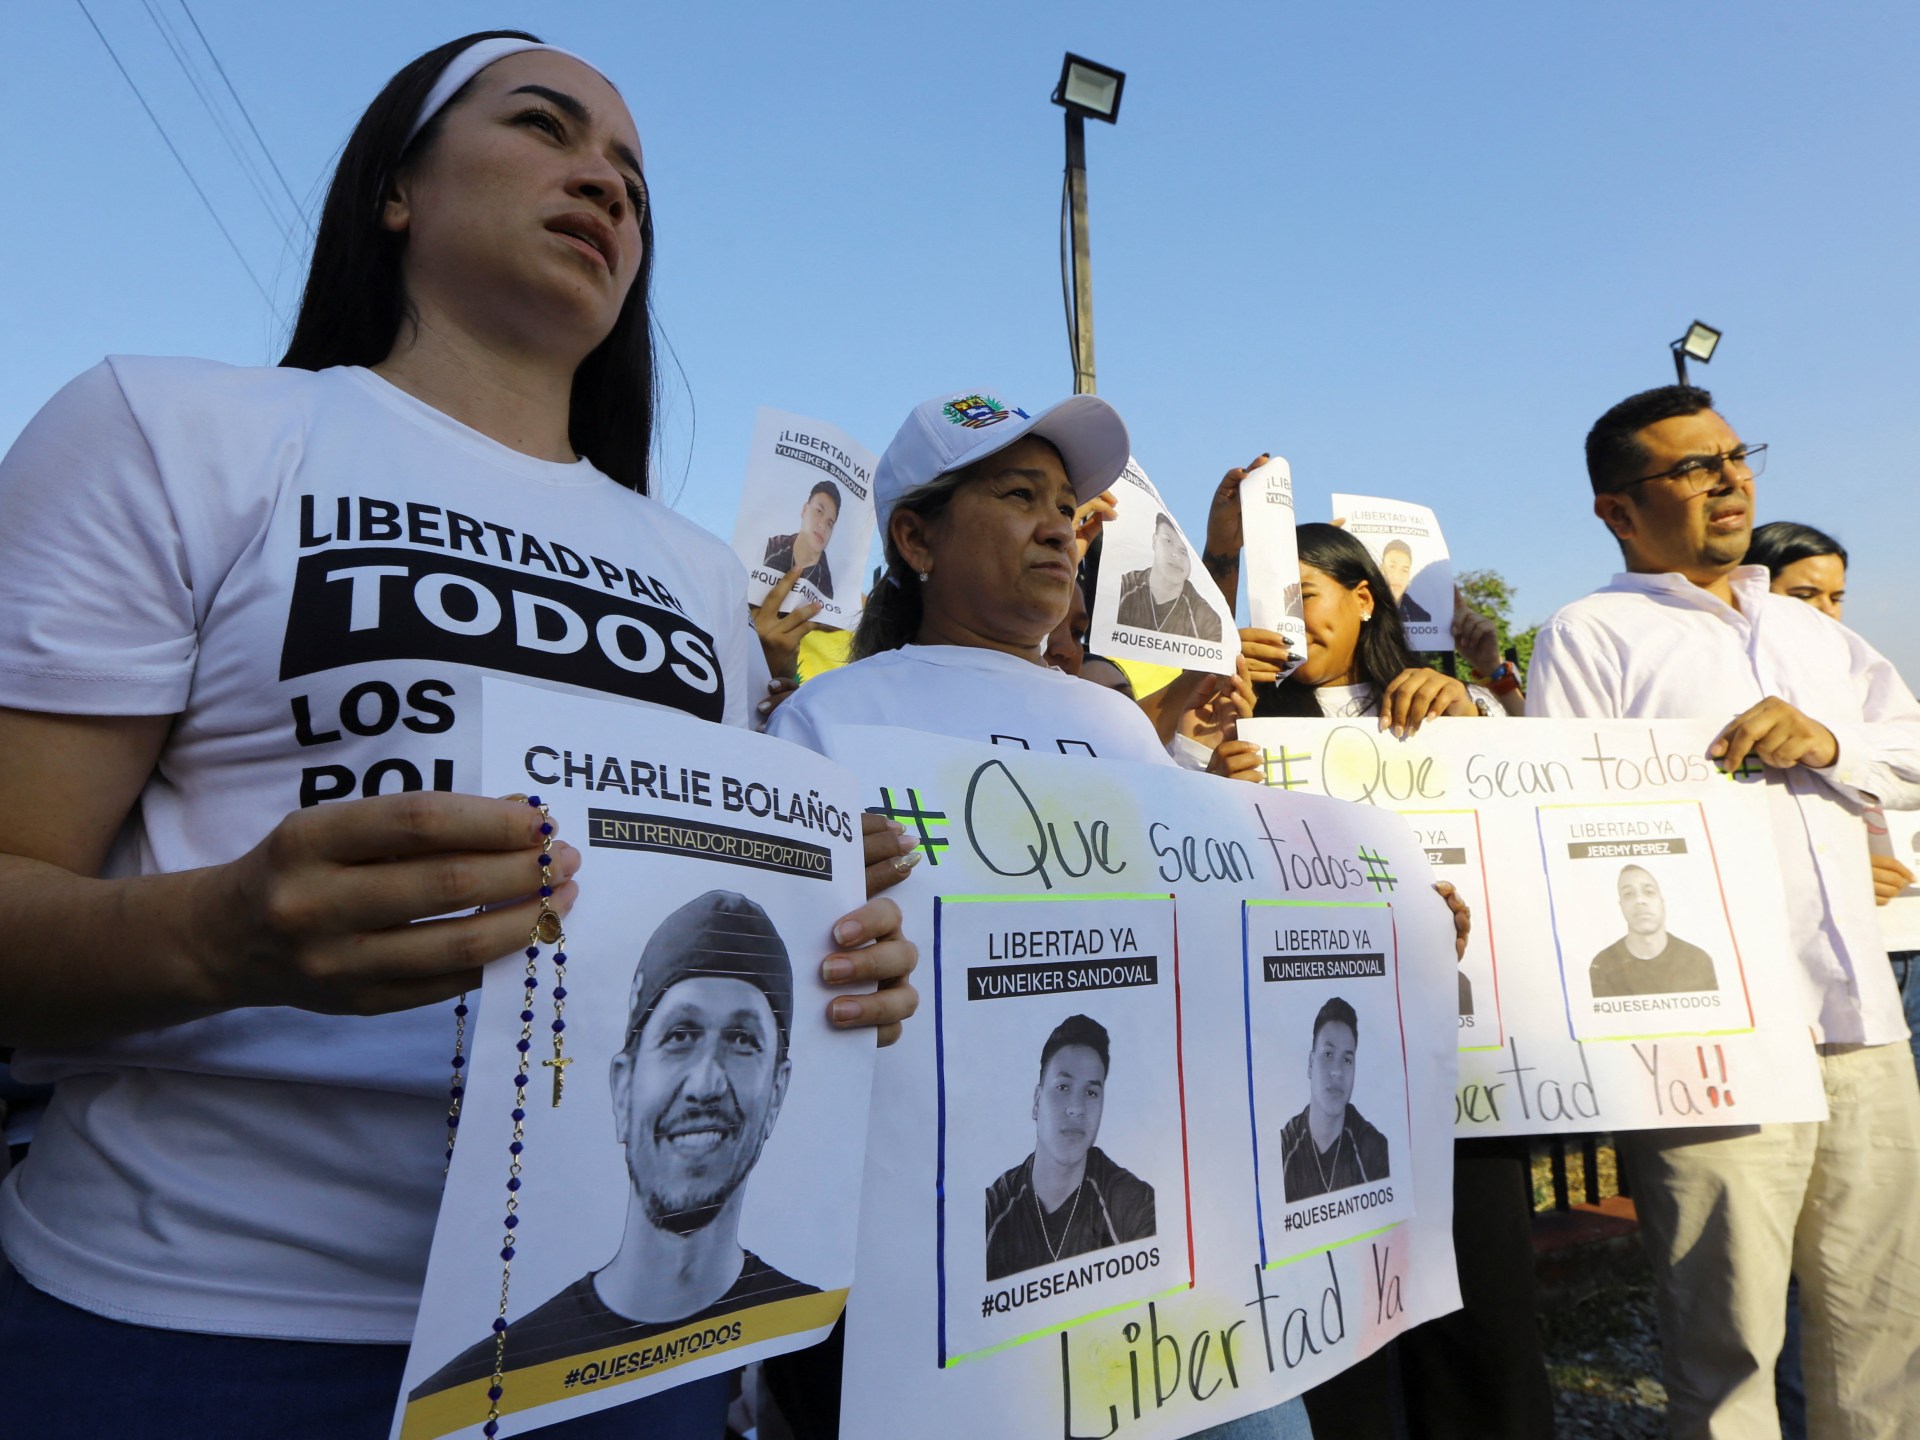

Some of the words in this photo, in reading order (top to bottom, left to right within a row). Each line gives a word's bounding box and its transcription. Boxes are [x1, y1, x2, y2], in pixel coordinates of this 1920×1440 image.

[776, 445, 829, 470] YUNEIKER
[829, 465, 866, 500] SANDOVAL
[780, 430, 851, 469] ¡LIBERTAD
[854, 463, 871, 484] YA!
[299, 494, 590, 580] LIBERTAD
[750, 569, 842, 615] #QUEANTODOS
[326, 565, 718, 694] TODOS
[1111, 631, 1223, 660] #QUESEANTODOS
[290, 679, 455, 746] LOS
[524, 745, 712, 807] CHARLIE
[722, 776, 854, 843] BOLAÑOS
[602, 819, 737, 855] ENTRENADOR
[740, 839, 826, 871] DEPORTIVO
[1427, 830, 1448, 845] YA
[1570, 822, 1650, 838] LIBERTAD
[1653, 820, 1676, 835] YA
[1587, 844, 1632, 858] JEREMY
[1633, 843, 1671, 855] PEREZ
[989, 929, 1104, 960] LIBERTAD
[1110, 928, 1138, 953] YA
[1275, 930, 1350, 951] LIBERTAD
[1352, 929, 1372, 949] YA
[976, 972, 1064, 997] YUNEIKER
[1067, 968, 1152, 992] SANDOVAL
[1269, 962, 1326, 979] YUNEIKER
[1326, 959, 1382, 977] SANDOVAL
[1592, 994, 1722, 1015] #QUESEANTODOS
[1283, 1186, 1395, 1233] #QUESEANTODOS
[982, 1247, 1161, 1319] #QUESEANTODOS
[564, 1321, 743, 1389] #QUESEANTODOS
[1061, 1250, 1346, 1440] Libertad
[1372, 1243, 1404, 1325] Ya
